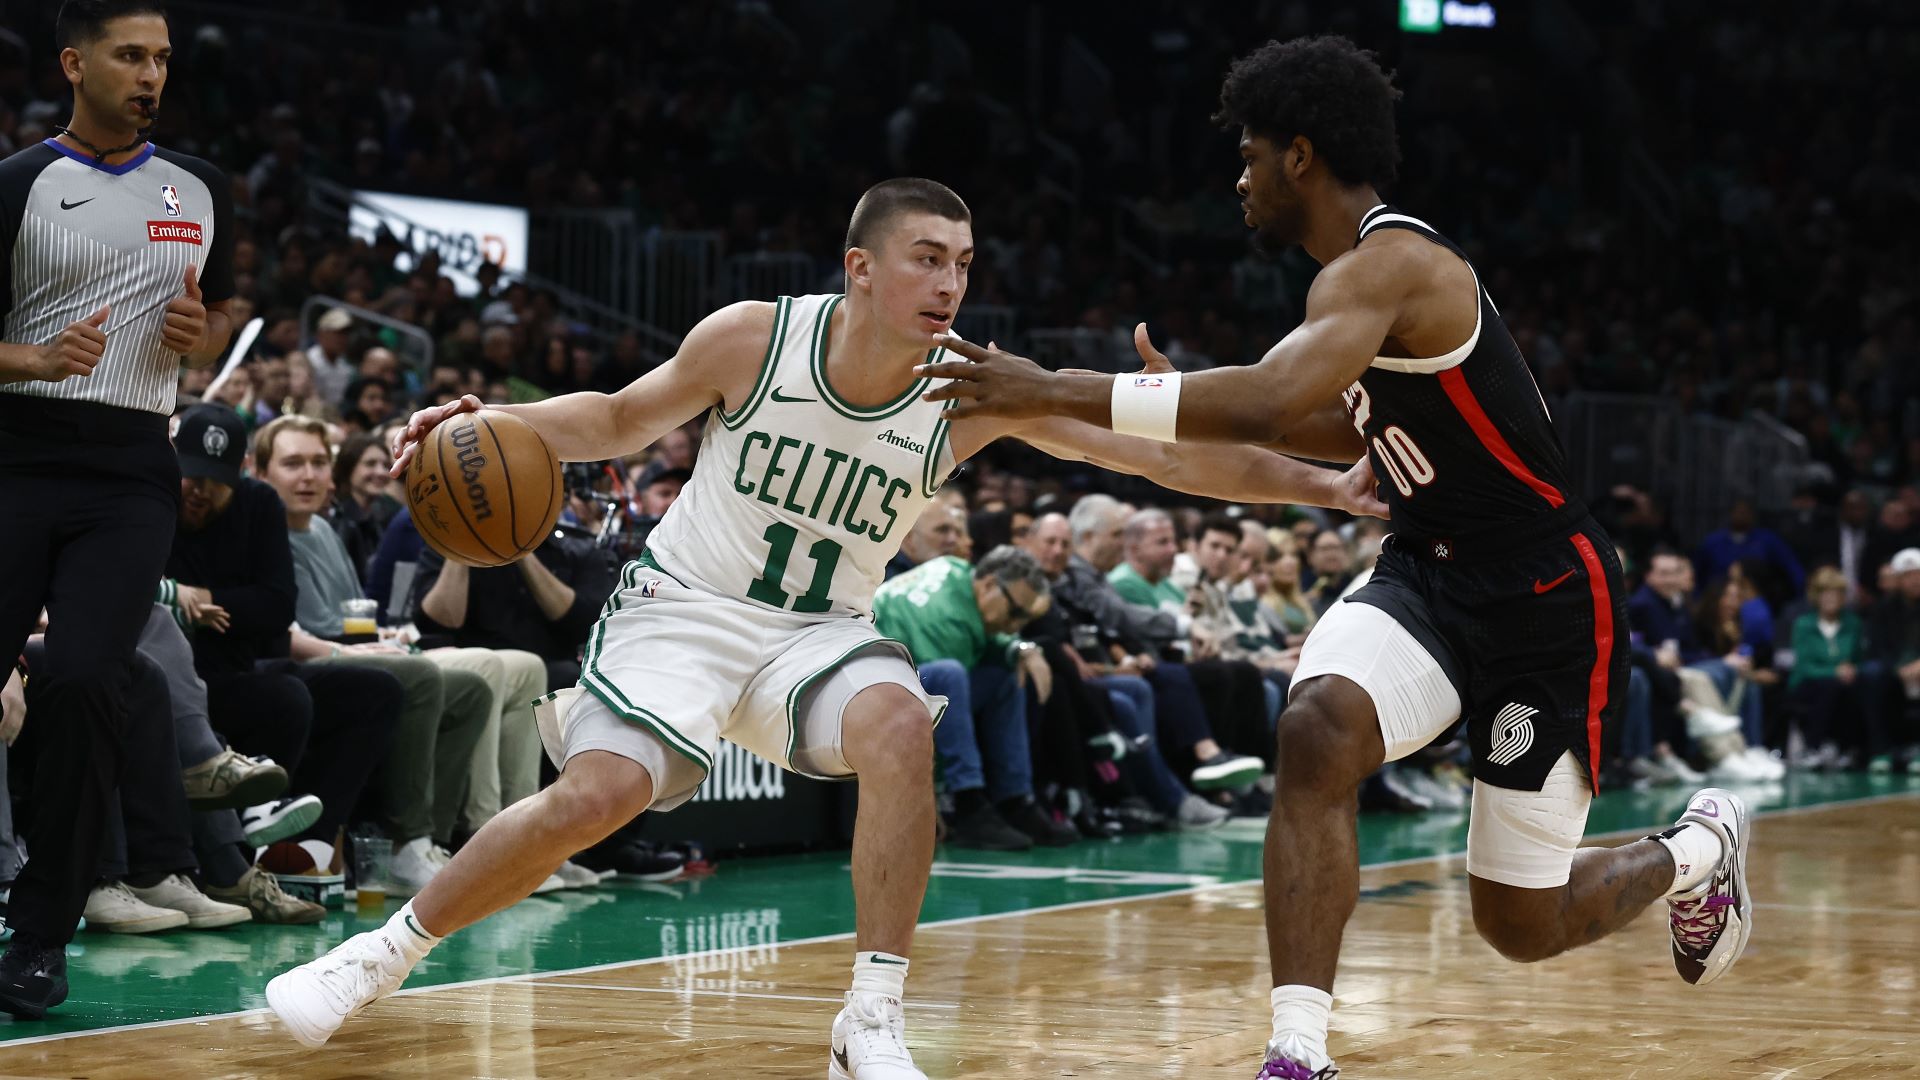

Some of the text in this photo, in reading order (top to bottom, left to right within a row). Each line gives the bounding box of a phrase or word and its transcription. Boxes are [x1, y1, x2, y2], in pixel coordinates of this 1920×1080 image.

[149, 225, 202, 240] Emirates
[451, 422, 494, 523] Wilson
[877, 429, 925, 455] Amica
[1373, 426, 1435, 497] 00
[734, 431, 912, 543] CELTICS
[746, 521, 843, 612] 11
[692, 738, 785, 801] mica
